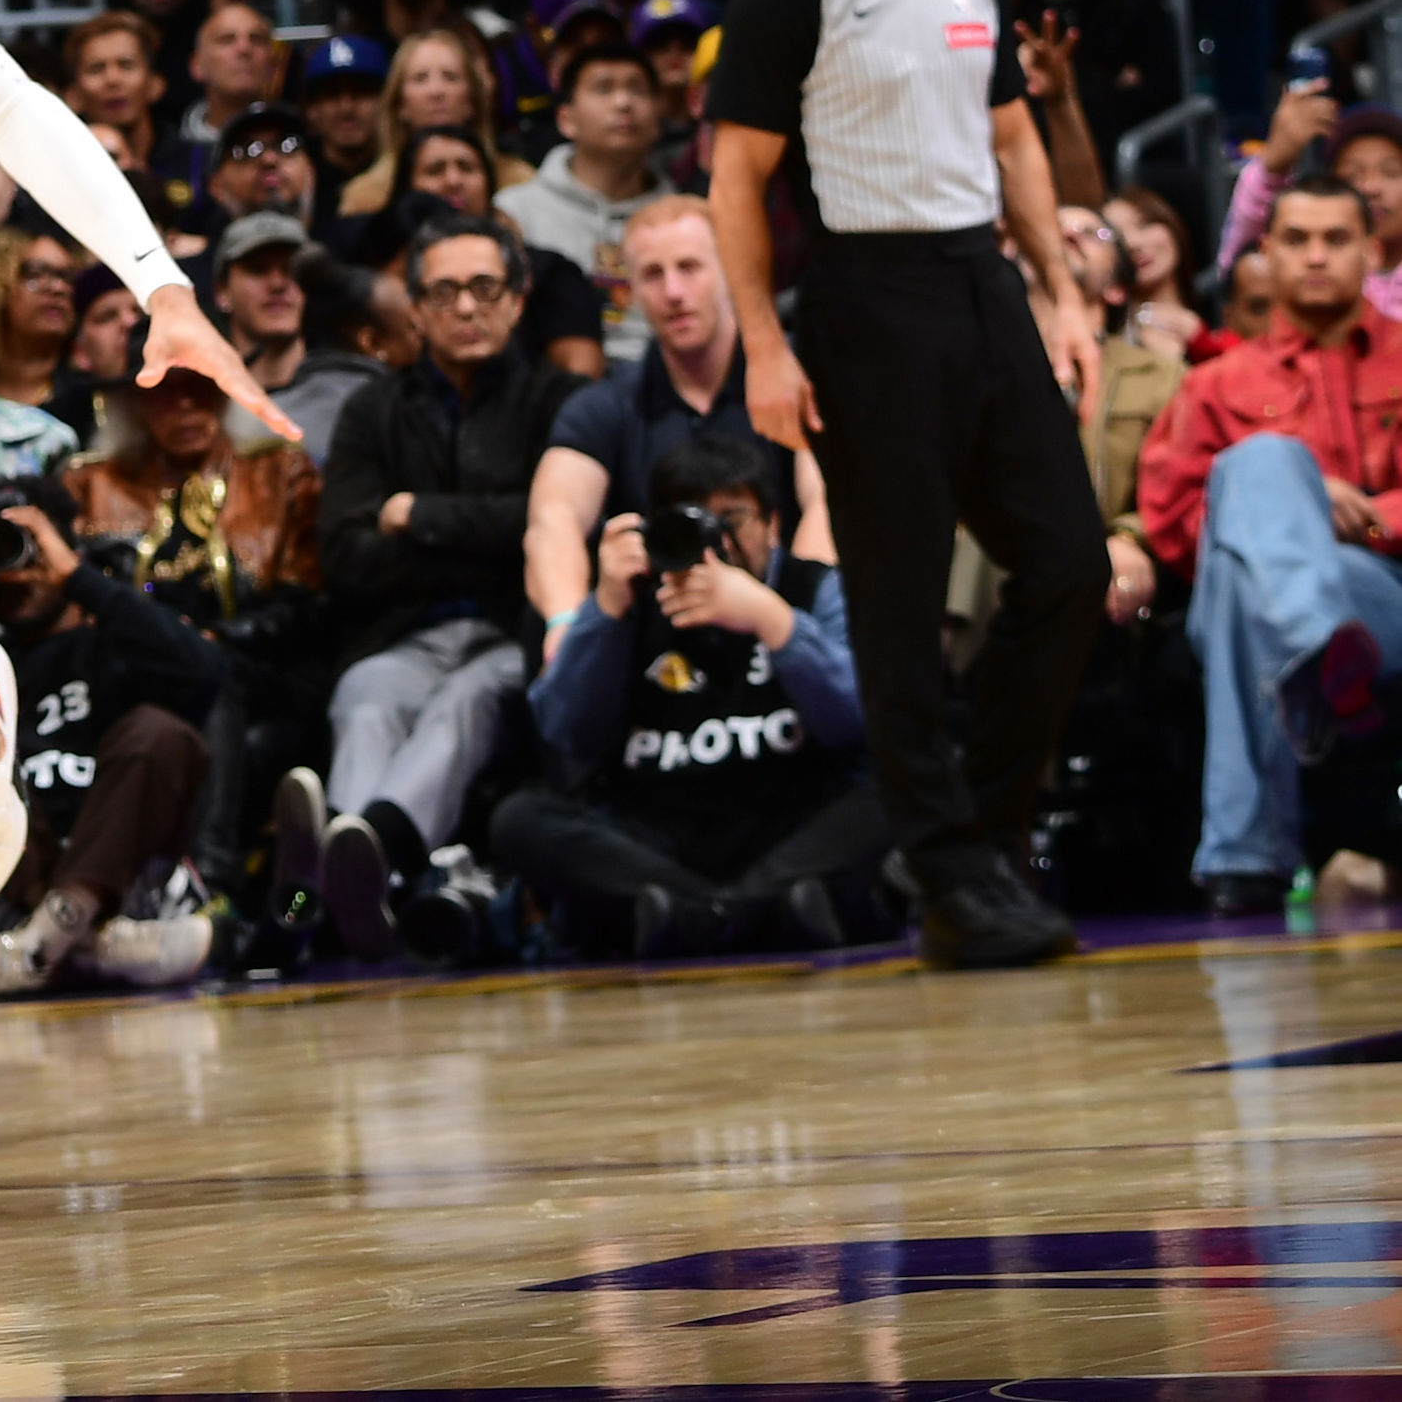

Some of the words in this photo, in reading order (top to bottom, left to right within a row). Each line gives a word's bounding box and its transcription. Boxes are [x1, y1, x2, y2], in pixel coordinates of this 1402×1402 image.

[36, 679, 91, 736] 23
[623, 707, 804, 772] PHOTO
[19, 749, 96, 789] TO
